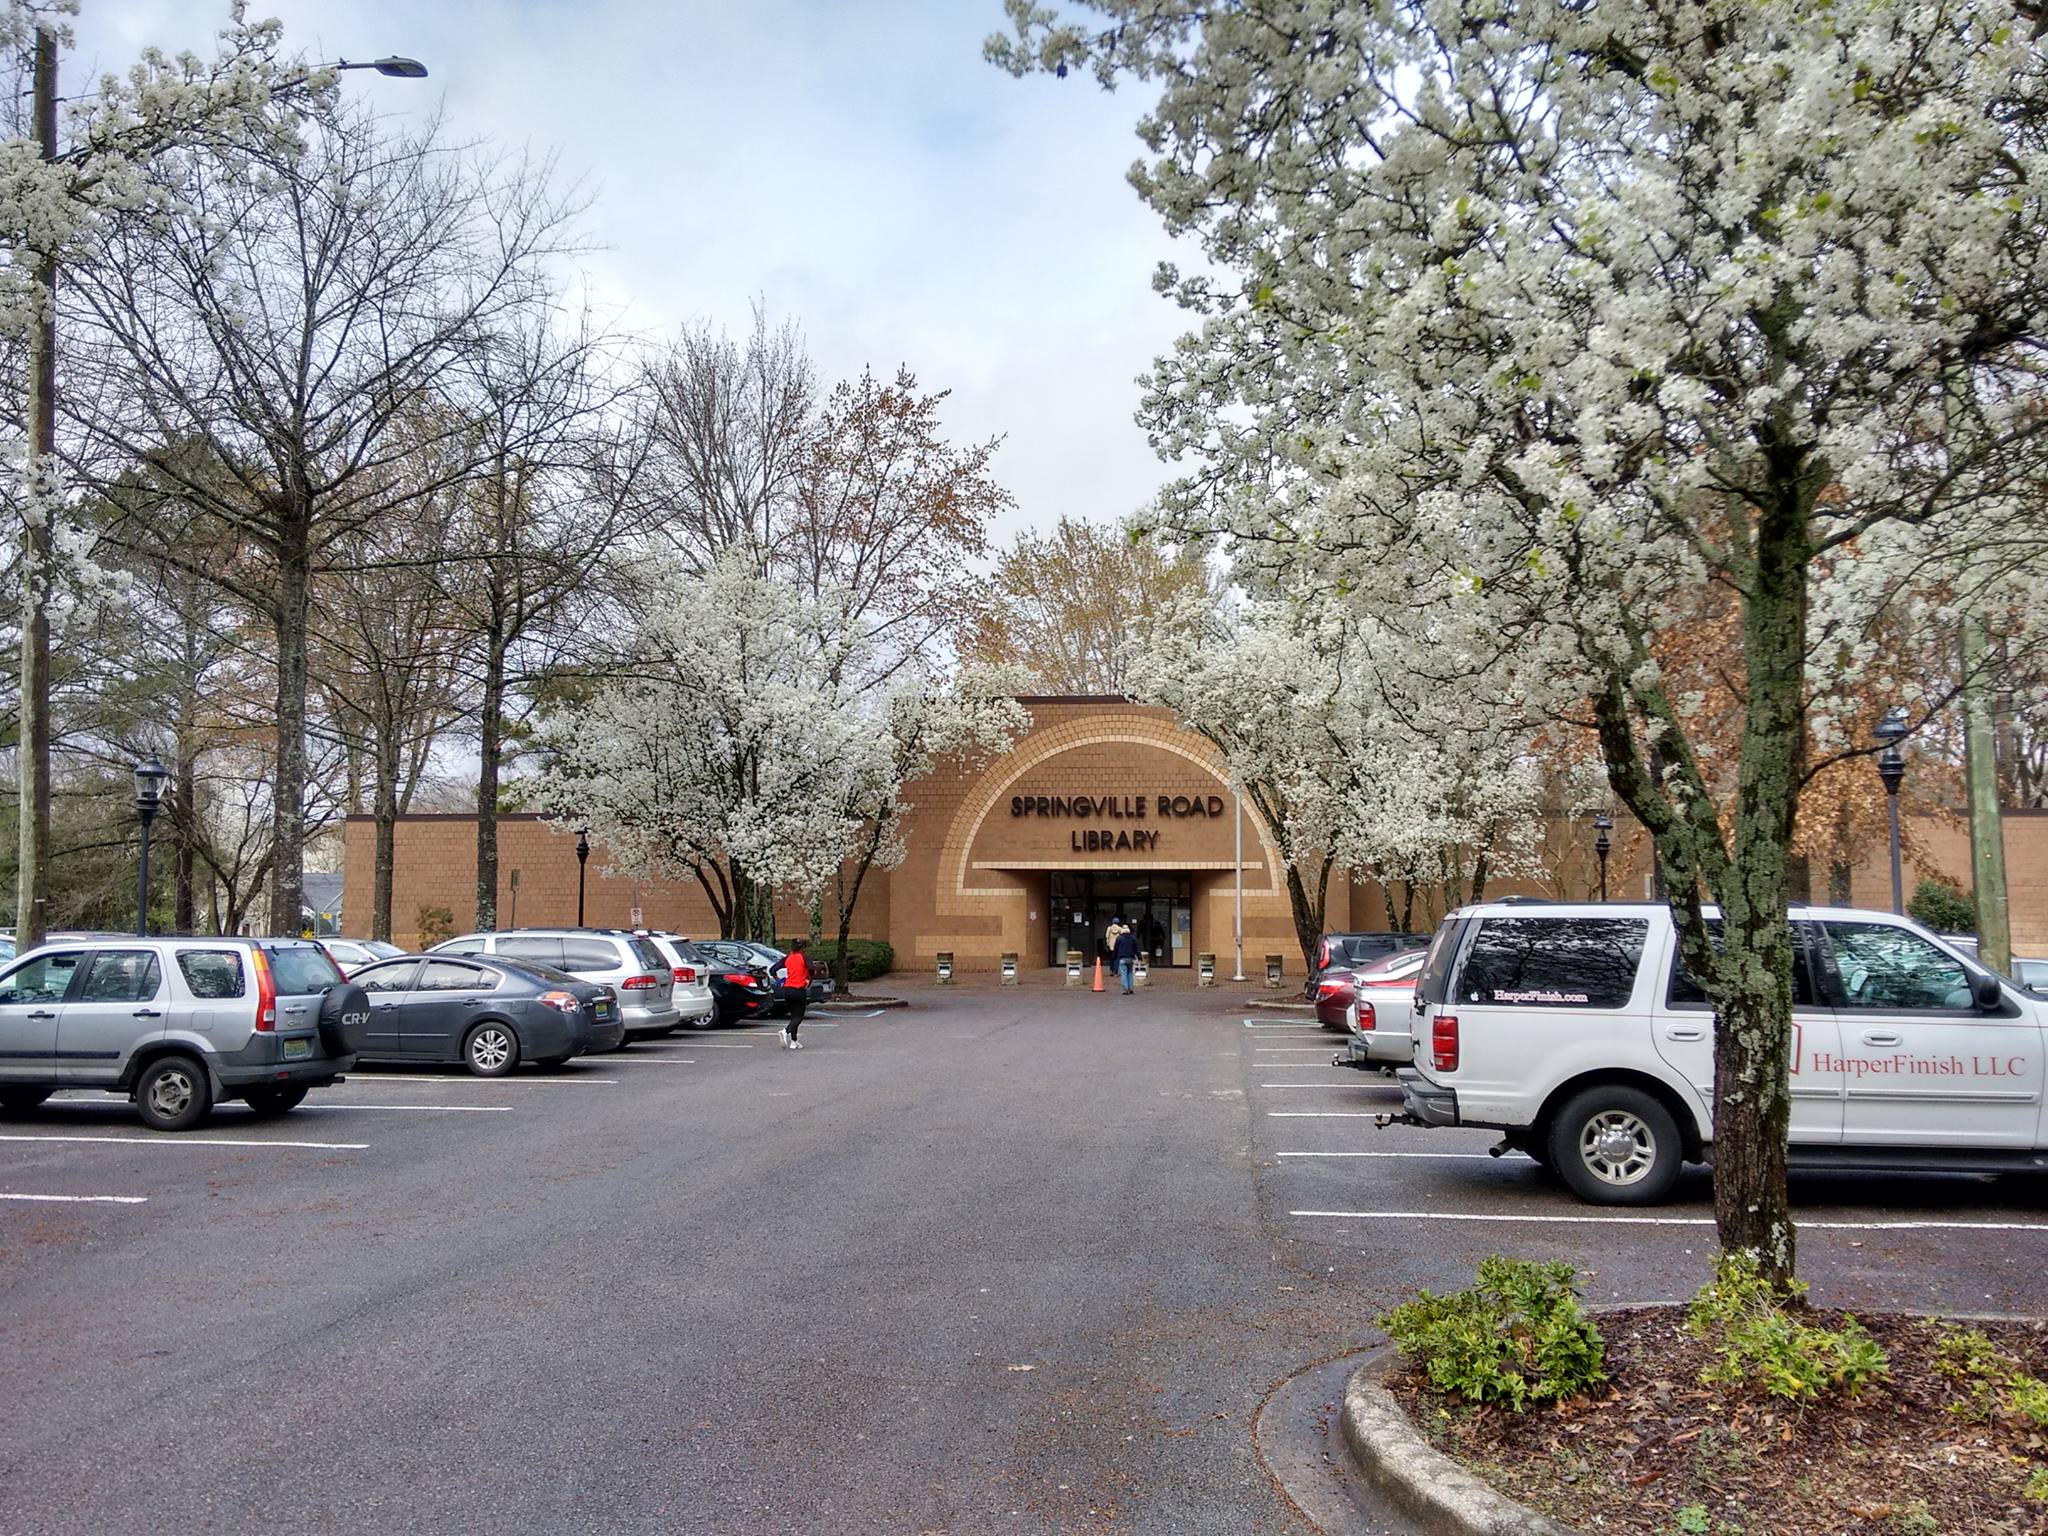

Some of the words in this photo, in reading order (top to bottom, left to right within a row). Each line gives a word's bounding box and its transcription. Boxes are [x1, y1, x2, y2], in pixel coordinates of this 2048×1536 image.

[1011, 796, 1146, 817] SPRINGVILLE
[1158, 796, 1224, 817] ROAD
[1071, 830, 1158, 852] LIBRARY
[1494, 990, 1589, 1003] HarperFinish.com
[341, 1012, 370, 1025] CR-V
[1813, 1053, 1964, 1078] HarperFinish
[1972, 1056, 2025, 1076] LLC
